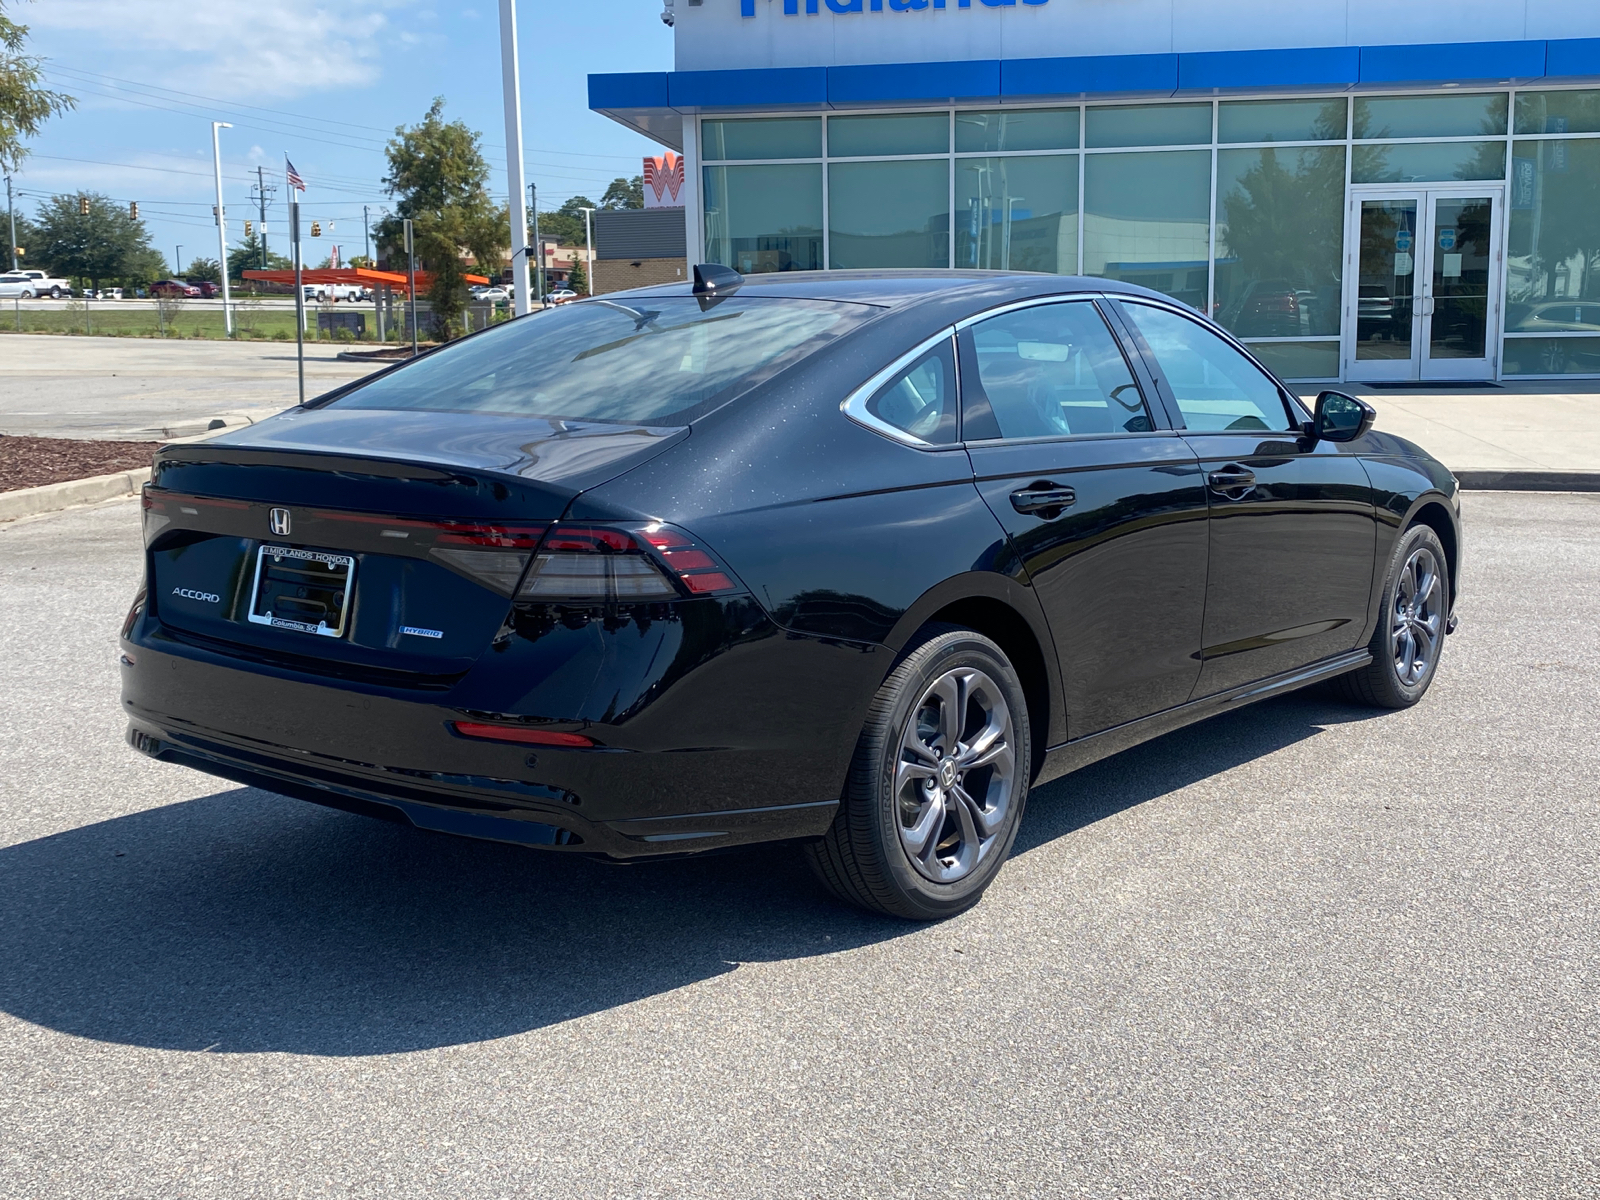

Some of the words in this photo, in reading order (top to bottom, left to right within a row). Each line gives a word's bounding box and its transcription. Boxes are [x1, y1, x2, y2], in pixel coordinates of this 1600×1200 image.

[269, 547, 313, 559] MIDLANDS
[315, 554, 348, 564] HONDA
[171, 587, 220, 603] ACCORD
[405, 627, 440, 637] HYBRID
[886, 754, 894, 774] GT
